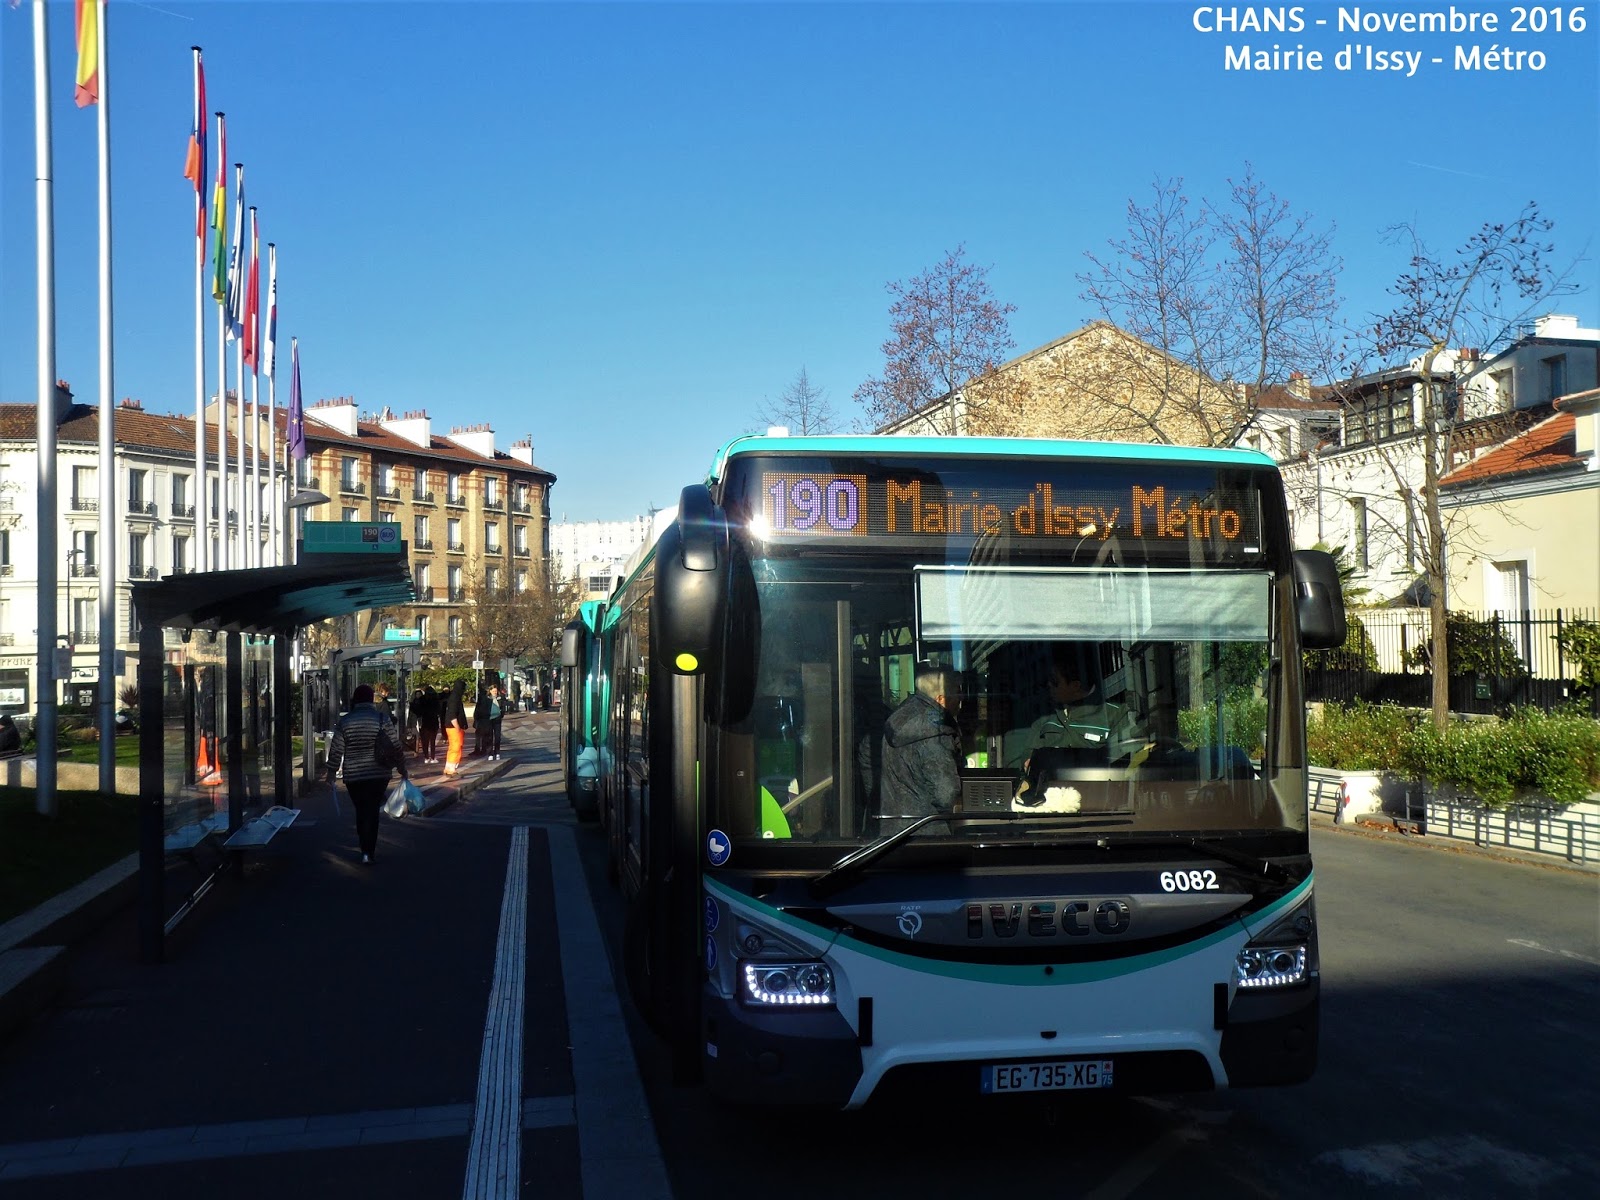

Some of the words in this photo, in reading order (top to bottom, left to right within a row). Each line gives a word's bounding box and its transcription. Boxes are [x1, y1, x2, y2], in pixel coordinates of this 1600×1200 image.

[768, 478, 860, 532] 190
[886, 479, 1000, 533] Mairie
[1014, 483, 1121, 541] d'Issy
[1132, 485, 1241, 539] Métro
[363, 528, 378, 536] 190
[1160, 869, 1220, 893] 6082
[967, 900, 1132, 940] IVECO
[1102, 1074, 1113, 1086] 75
